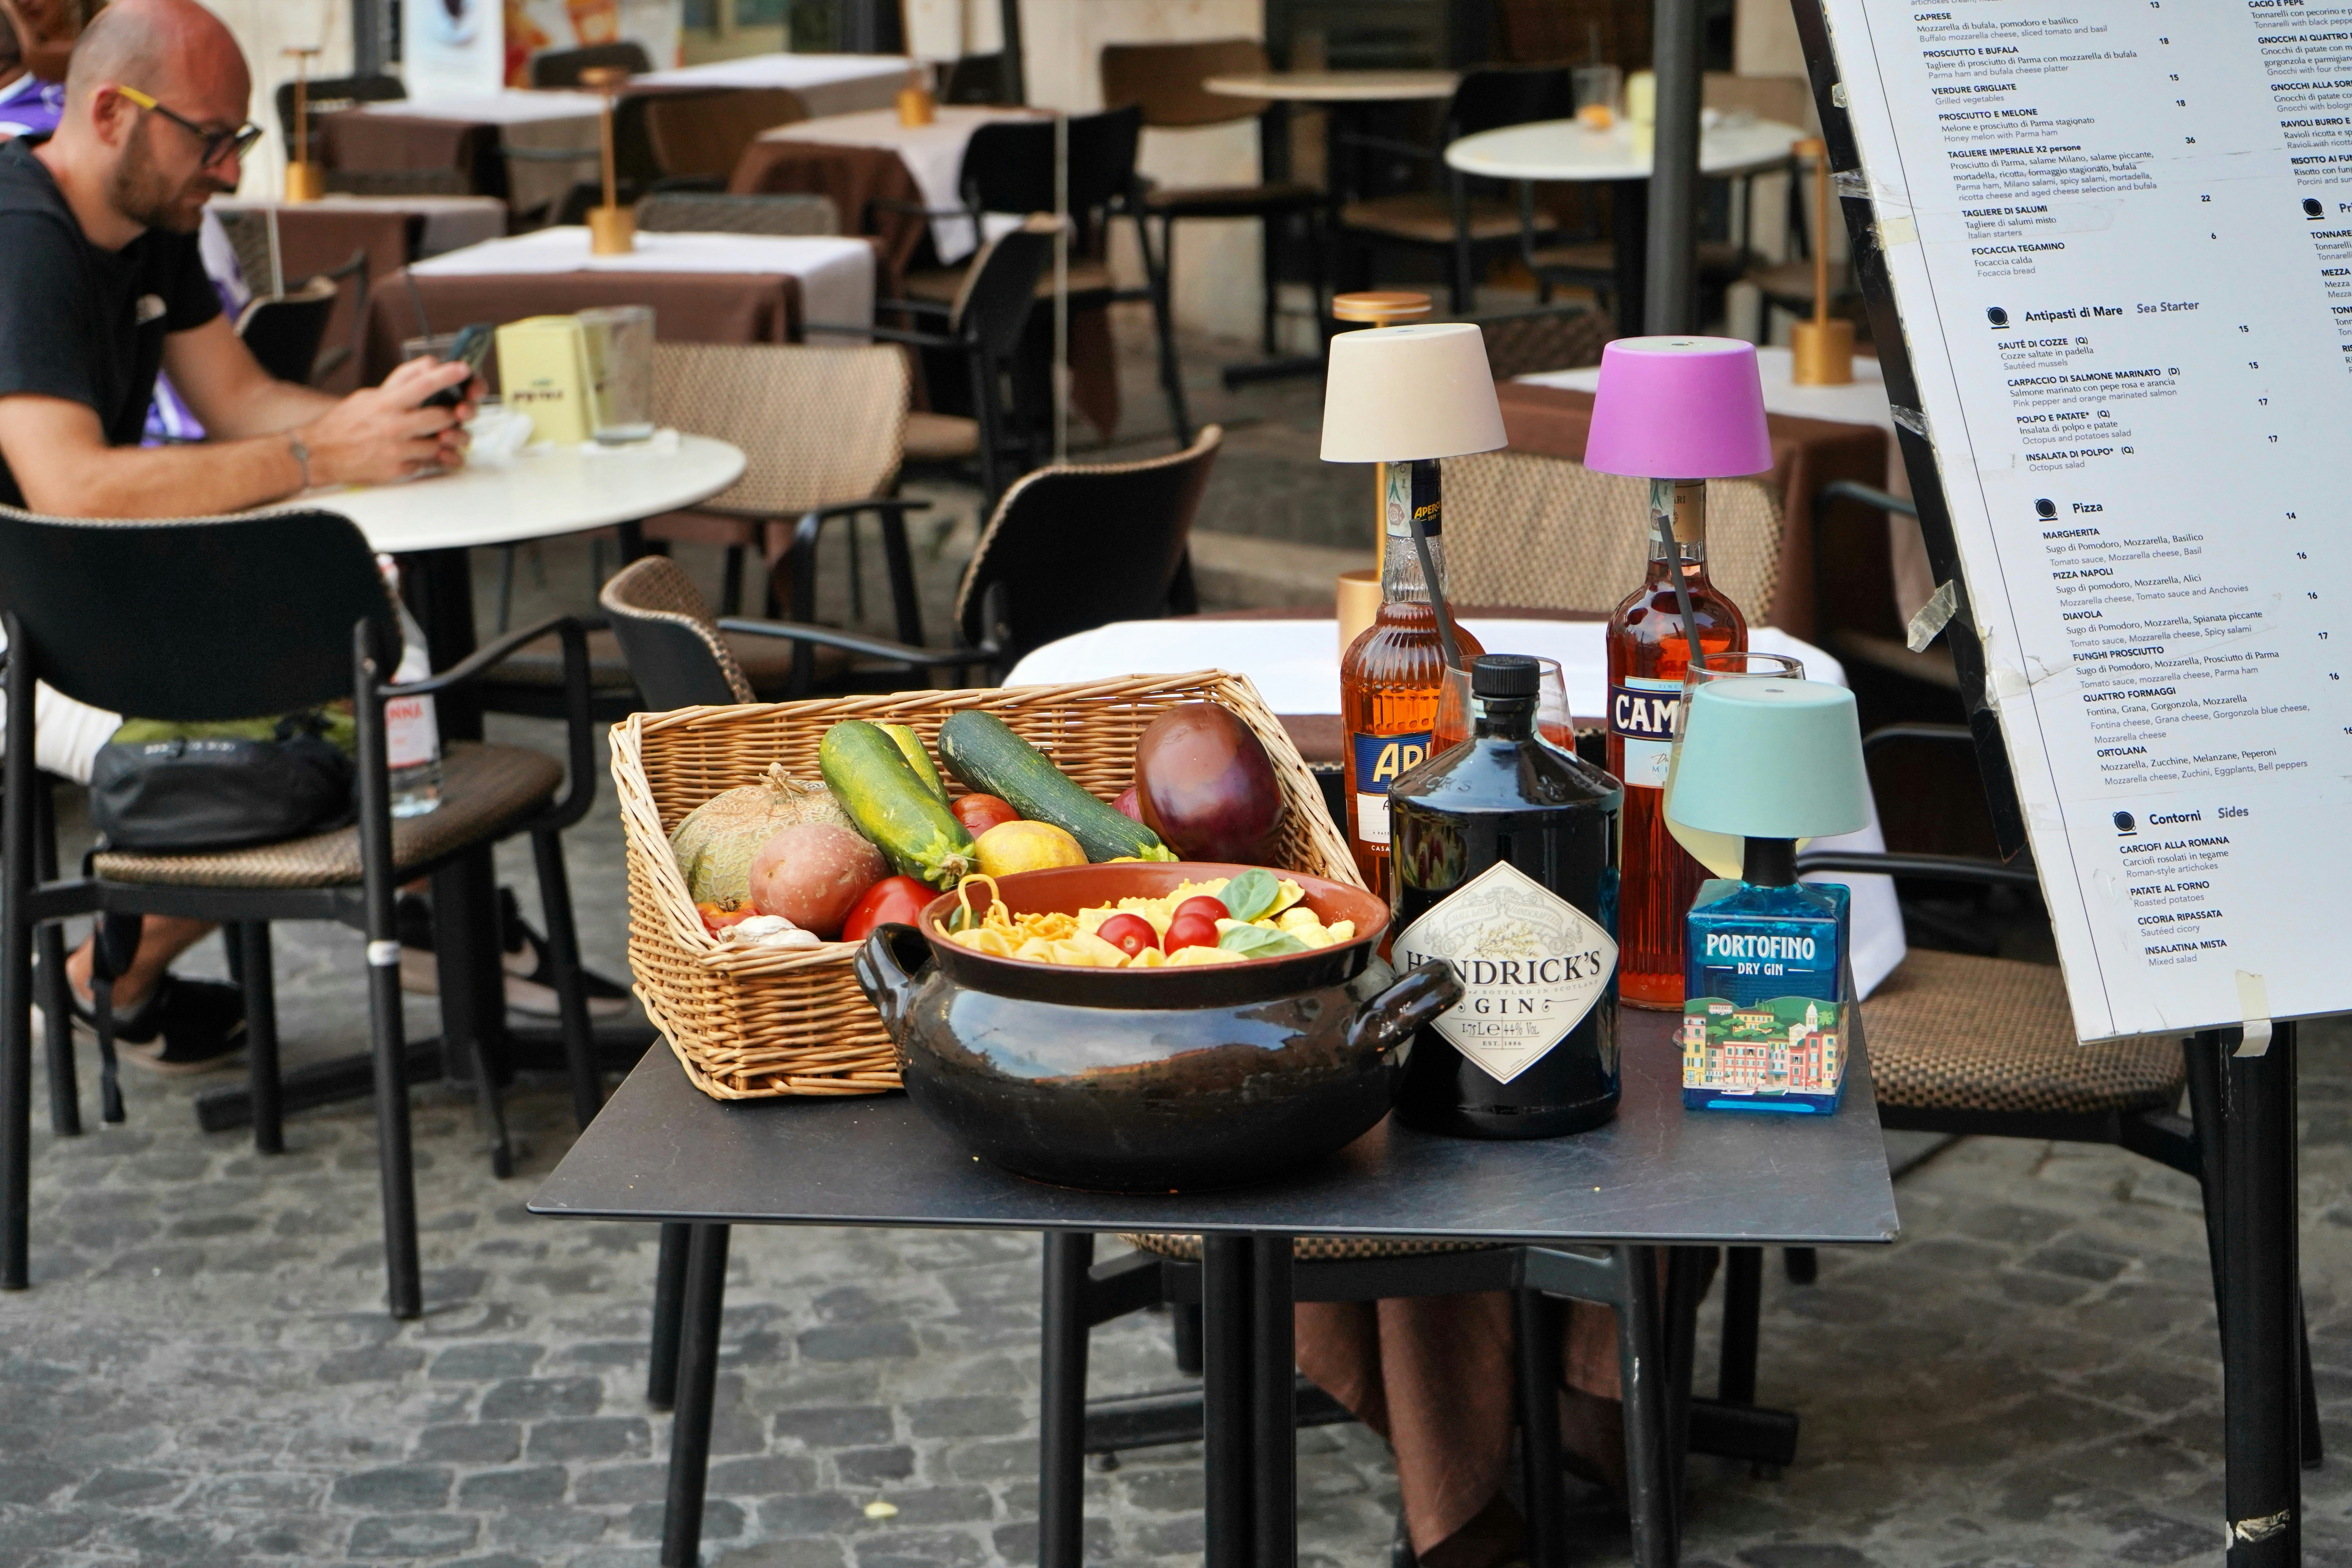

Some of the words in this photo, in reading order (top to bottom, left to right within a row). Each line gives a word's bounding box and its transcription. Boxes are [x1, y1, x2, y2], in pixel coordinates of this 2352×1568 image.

[2248, 0, 2275, 8] CACIO
[1914, 13, 1952, 21] CAPRESE
[1917, 23, 1960, 33] Mozzarella
[1971, 21, 1998, 29] bufala,
[2000, 19, 2040, 30] pomodoro
[2048, 17, 2078, 25] basilico
[2258, 35, 2297, 44] GNOCCHI
[2309, 33, 2348, 41] QUATTRO
[1923, 48, 1976, 58] PROSCIUTTO
[1985, 46, 2019, 54] BUFALA
[1931, 86, 1972, 95] VERDURE
[1973, 83, 2017, 93] GRIGLIATE
[2270, 82, 2310, 91] GNOCCHI
[1935, 96, 1961, 105] Grilled
[1963, 94, 2004, 105] vegetables
[1938, 111, 1992, 121] PROSCIUTTO
[2001, 108, 2038, 117] MELONE
[2280, 119, 2314, 128] RAVIOLI
[2314, 117, 2343, 126] BURRO
[1947, 149, 1988, 158] TAGLIERE
[1989, 146, 2035, 156] IMPERIALE
[2049, 145, 2082, 154] persone
[2290, 156, 2327, 165] RISOTTO
[1961, 208, 2003, 218] TAGLIERE
[2015, 205, 2048, 214] SALUMI
[1971, 245, 2017, 256] FOCACCIA
[2017, 242, 2065, 252] TEGAMINO
[2313, 241, 2352, 250] Tonnarelli
[1978, 269, 2011, 277] Focaccia
[2013, 266, 2036, 275] bread
[2321, 268, 2352, 277] MEZZA
[2025, 308, 2077, 323] Antipasti
[2080, 307, 2091, 318] di
[2092, 306, 2123, 317] Mare
[2136, 303, 2157, 314] Sea
[2160, 301, 2200, 312] Starter
[1998, 339, 2027, 350] SAUTÉ
[2039, 338, 2069, 347] COZZE
[2075, 336, 2088, 345] (Q)
[2007, 376, 2057, 387] CARPACCIO
[2070, 372, 2114, 382] SALMONE
[2114, 368, 2161, 379] MARINATO
[2168, 367, 2180, 376] (D)
[2016, 415, 2046, 424] POLPO
[2097, 410, 2110, 419] (Q)
[2019, 425, 2050, 434] Insalata
[2052, 424, 2060, 432] di
[2062, 423, 2085, 434] polpo
[2094, 421, 2118, 431] patate
[2025, 451, 2068, 461] INSALATA
[2069, 450, 2079, 458] DI
[2121, 446, 2134, 455] (Q)
[2268, 435, 2278, 443] 17
[2029, 464, 2063, 472] Octopus
[2065, 460, 2085, 469] salad
[2072, 502, 2103, 514] Pizza
[2042, 528, 2100, 540] MARGHERITA
[2053, 571, 2079, 580] PIZZA
[2080, 568, 2114, 578] NAPOLI
[2296, 552, 2307, 560] 16
[2056, 586, 2076, 595] Sugo
[2078, 583, 2086, 592] di
[2088, 581, 2132, 593] pomodoro,
[2134, 575, 2181, 587] Mozzarella,
[2183, 574, 2201, 583] Alici
[2062, 610, 2103, 621] DIAVOLA
[2307, 592, 2318, 600] 16
[2073, 651, 2108, 662] FUNGHI
[2109, 646, 2164, 658] PROSCIUTTO
[2318, 632, 2328, 640] 17
[2083, 691, 2125, 702] QUATTRO
[2127, 687, 2176, 699] FORMAGGI
[2328, 672, 2339, 681] 16
[2097, 746, 2148, 757] ORTOLANA
[2149, 809, 2202, 825] Contorni
[2218, 806, 2249, 819] Sides
[2120, 842, 2162, 854] CARCIOFI
[2164, 840, 2187, 850] ALLA
[2188, 836, 2230, 848] ROMANA
[2130, 885, 2162, 896] PATATE
[2164, 884, 2176, 893] AL
[2177, 880, 2210, 891] FORNO
[2134, 896, 2167, 907] Roasted
[2169, 895, 2205, 906] potatoes
[2137, 914, 2176, 926] CICORIA
[2176, 909, 2223, 921] RIPASSATA
[2141, 926, 2174, 937] Sautéed
[2177, 925, 2200, 933] cicory
[1706, 934, 1816, 960] PORTOFINO
[2145, 942, 2199, 955] INSALATINA
[2200, 939, 2228, 949] MISTA
[2149, 956, 2174, 966] Mixed
[2176, 953, 2197, 964] salad
[1406, 950, 1601, 985] HNDRICK'S
[1737, 962, 1760, 975] DRY
[1764, 963, 1783, 976] GIN
[1554, 980, 1598, 992] SCOTLAND
[1475, 998, 1534, 1014] GIN
[1503, 1022, 1523, 1036] 44%
